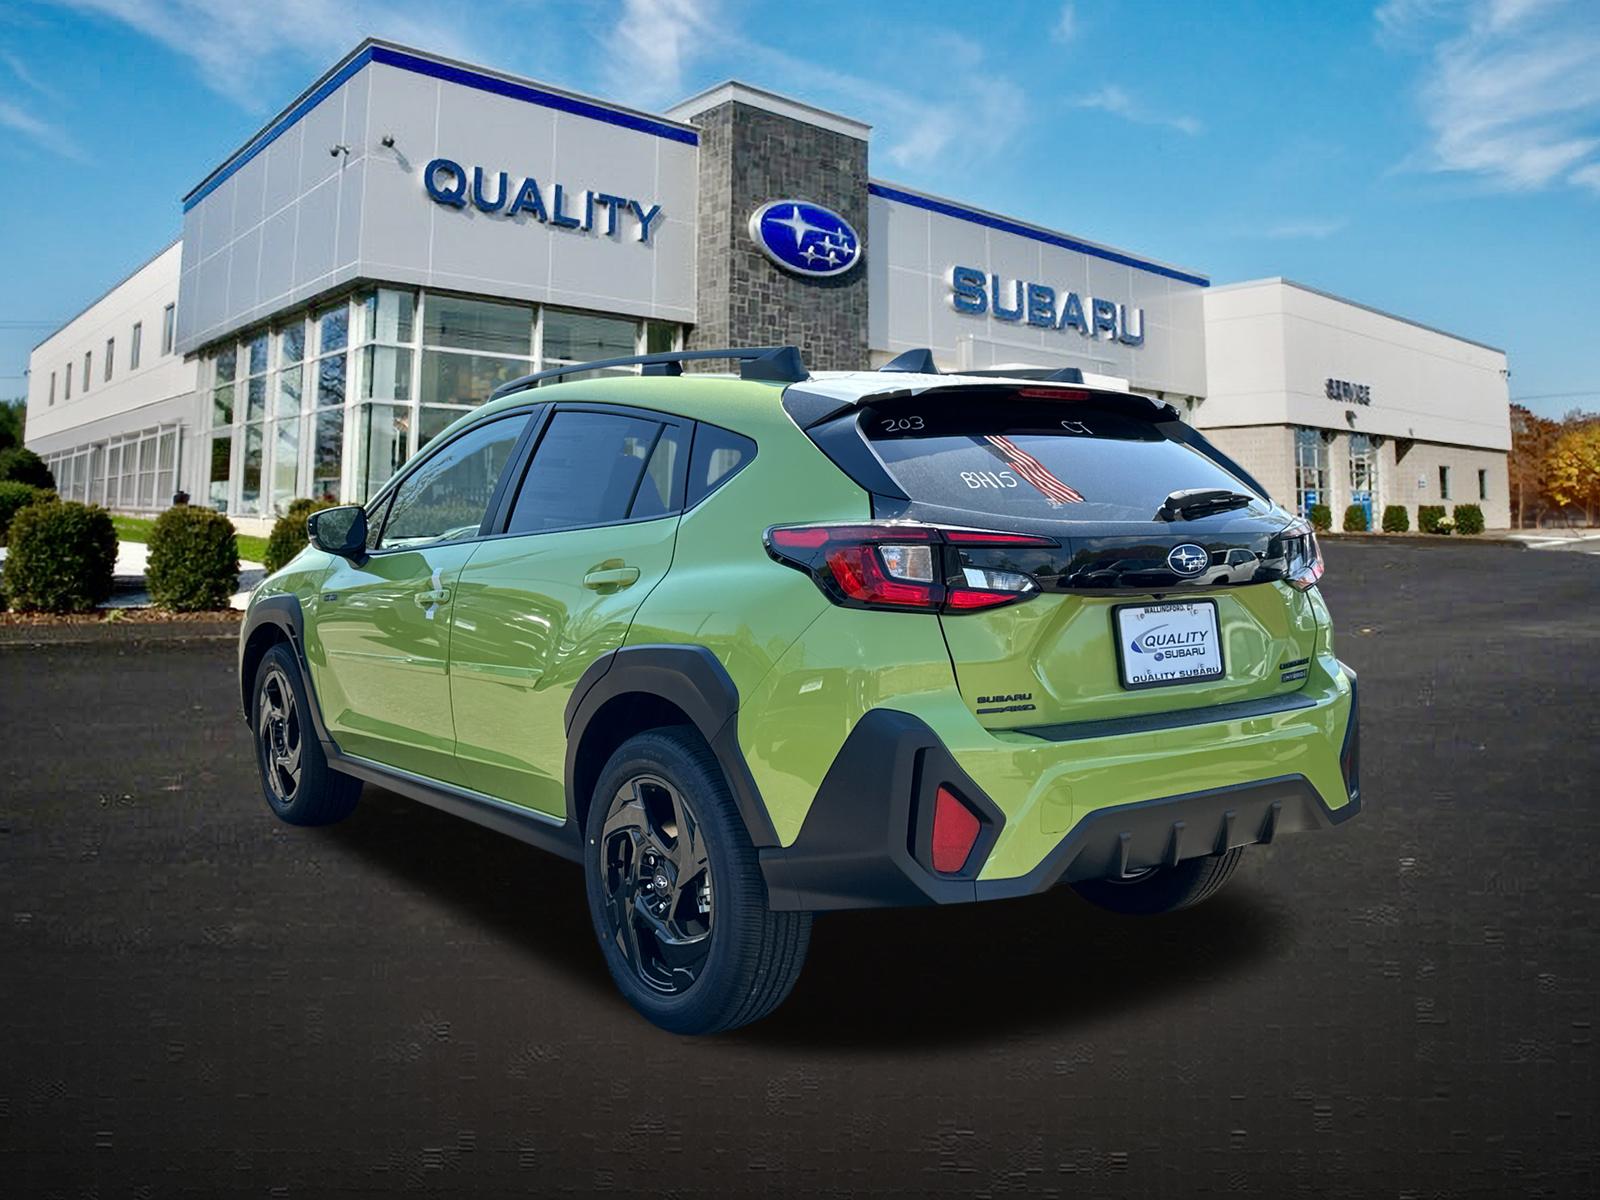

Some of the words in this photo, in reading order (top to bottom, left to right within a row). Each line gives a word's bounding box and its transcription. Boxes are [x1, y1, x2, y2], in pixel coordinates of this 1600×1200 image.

[423, 157, 663, 243] QUALITY
[949, 264, 1145, 347] SUBARU
[1325, 377, 1371, 407] SERVICE
[881, 415, 925, 432] 203
[1061, 420, 1093, 435] CT
[1145, 631, 1208, 647] QUALITY
[1165, 647, 1206, 659] SUBARU
[1132, 671, 1176, 683] QUALITY
[1179, 666, 1219, 678] SUBARU
[977, 693, 1032, 703] SUBARU
